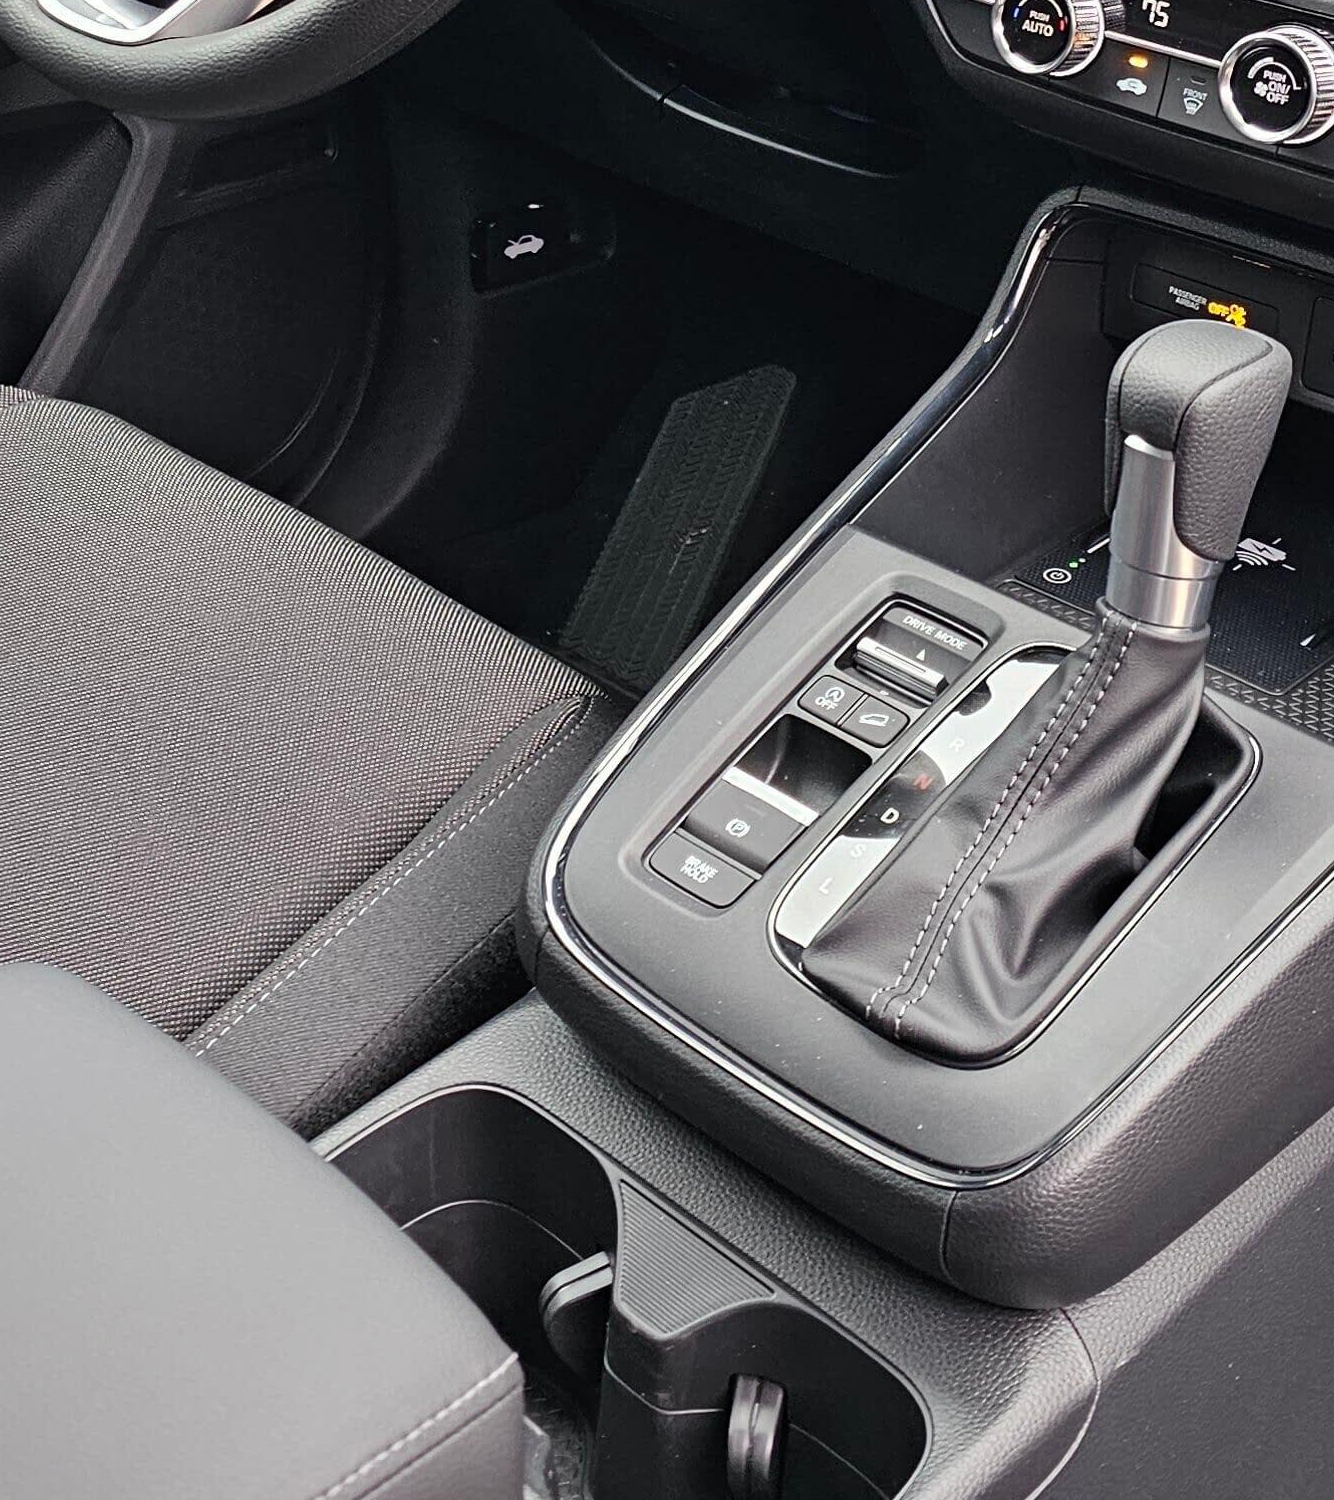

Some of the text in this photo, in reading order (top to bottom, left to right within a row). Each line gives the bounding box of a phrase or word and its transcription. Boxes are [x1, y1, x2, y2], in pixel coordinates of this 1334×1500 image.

[1029, 10, 1050, 22] PUSH
[1022, 19, 1054, 37] AUTO
[1263, 69, 1287, 82] PUSH
[1182, 87, 1208, 101] FRONT
[1266, 92, 1289, 105] OFF
[1168, 285, 1207, 305] PASSENGER
[1208, 302, 1230, 317] OFF
[902, 615, 967, 650] DRIVE MODE
[815, 696, 838, 710] OFF
[913, 773, 934, 790] N
[880, 807, 900, 824] D
[679, 863, 708, 884] HOLD
[684, 855, 718, 878] BRAKE
[818, 877, 833, 895] L
